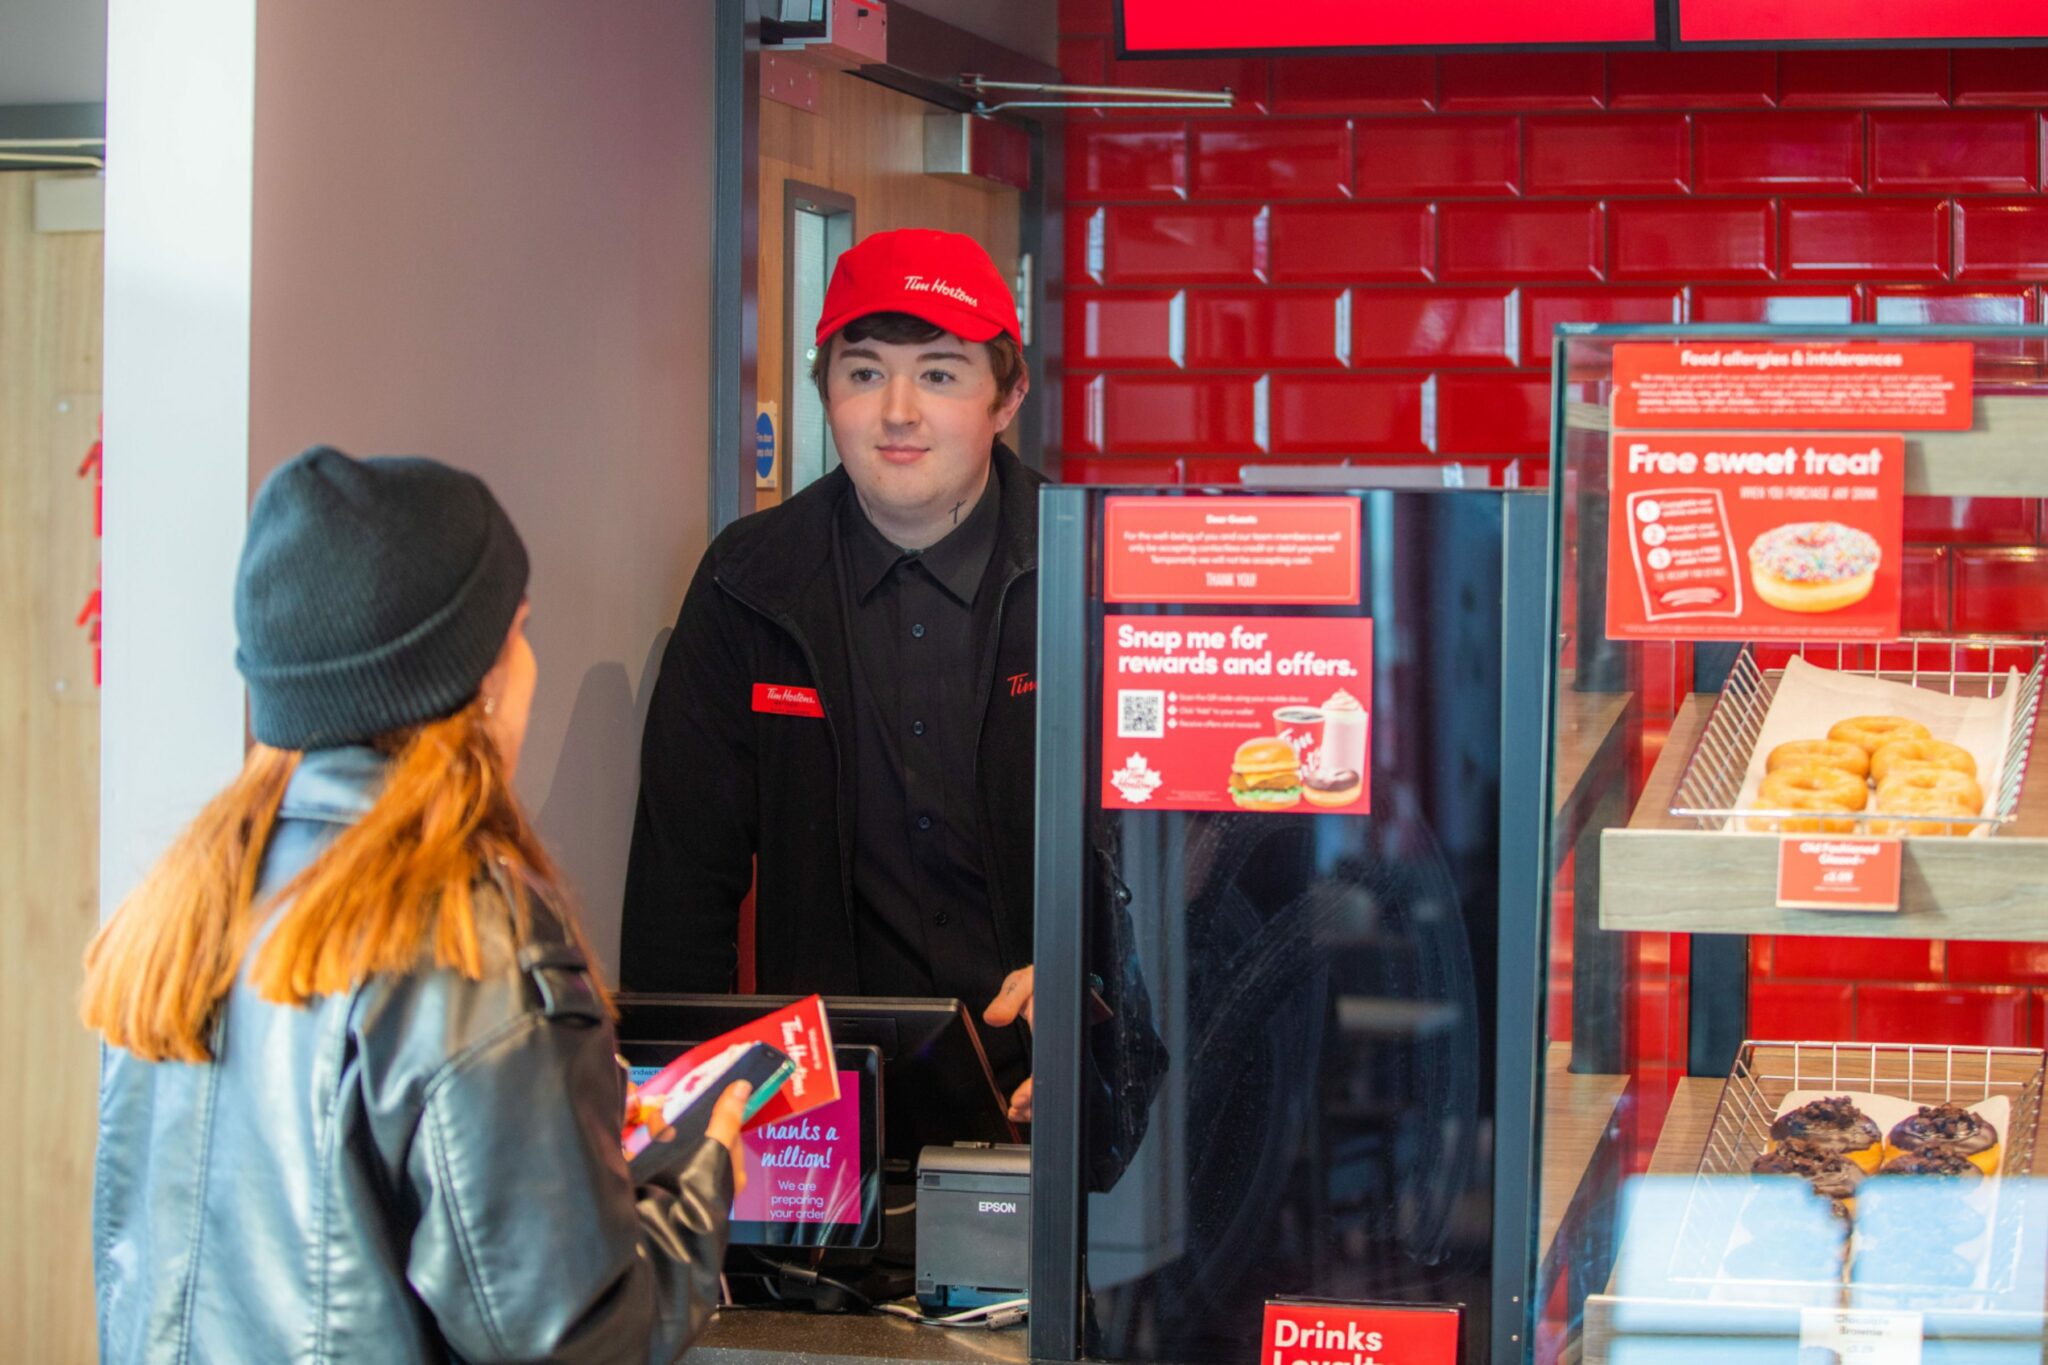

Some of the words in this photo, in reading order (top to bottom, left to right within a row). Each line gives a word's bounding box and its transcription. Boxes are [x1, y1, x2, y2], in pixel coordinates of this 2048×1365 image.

[904, 275, 929, 291] Tim
[931, 278, 977, 307] Hortons
[1681, 350, 1720, 367] Food
[1722, 350, 1790, 370] allergies
[1792, 350, 1804, 367] &
[1806, 350, 1903, 367] intolerances
[1628, 444, 1698, 474] Free
[1704, 448, 1797, 475] sweet
[1803, 447, 1883, 475] treat
[1206, 572, 1234, 587] THANK
[1118, 624, 1182, 655] Snap
[1187, 631, 1226, 650] me
[1230, 625, 1268, 650] for
[1118, 650, 1218, 674] rewards
[1223, 651, 1272, 675] and
[1276, 651, 1358, 677] offers.
[767, 688, 781, 701] Tim
[1007, 672, 1037, 696] Tim
[781, 1015, 803, 1046] Tim
[826, 1126, 840, 1140] a
[761, 1145, 832, 1168] million!
[778, 1181, 796, 1191] We
[798, 1183, 816, 1191] are
[771, 1194, 823, 1208] preparing
[979, 1202, 1016, 1213] EPSON
[769, 1209, 793, 1220] your
[796, 1208, 824, 1219] order
[1274, 1319, 1383, 1352] Drinks
